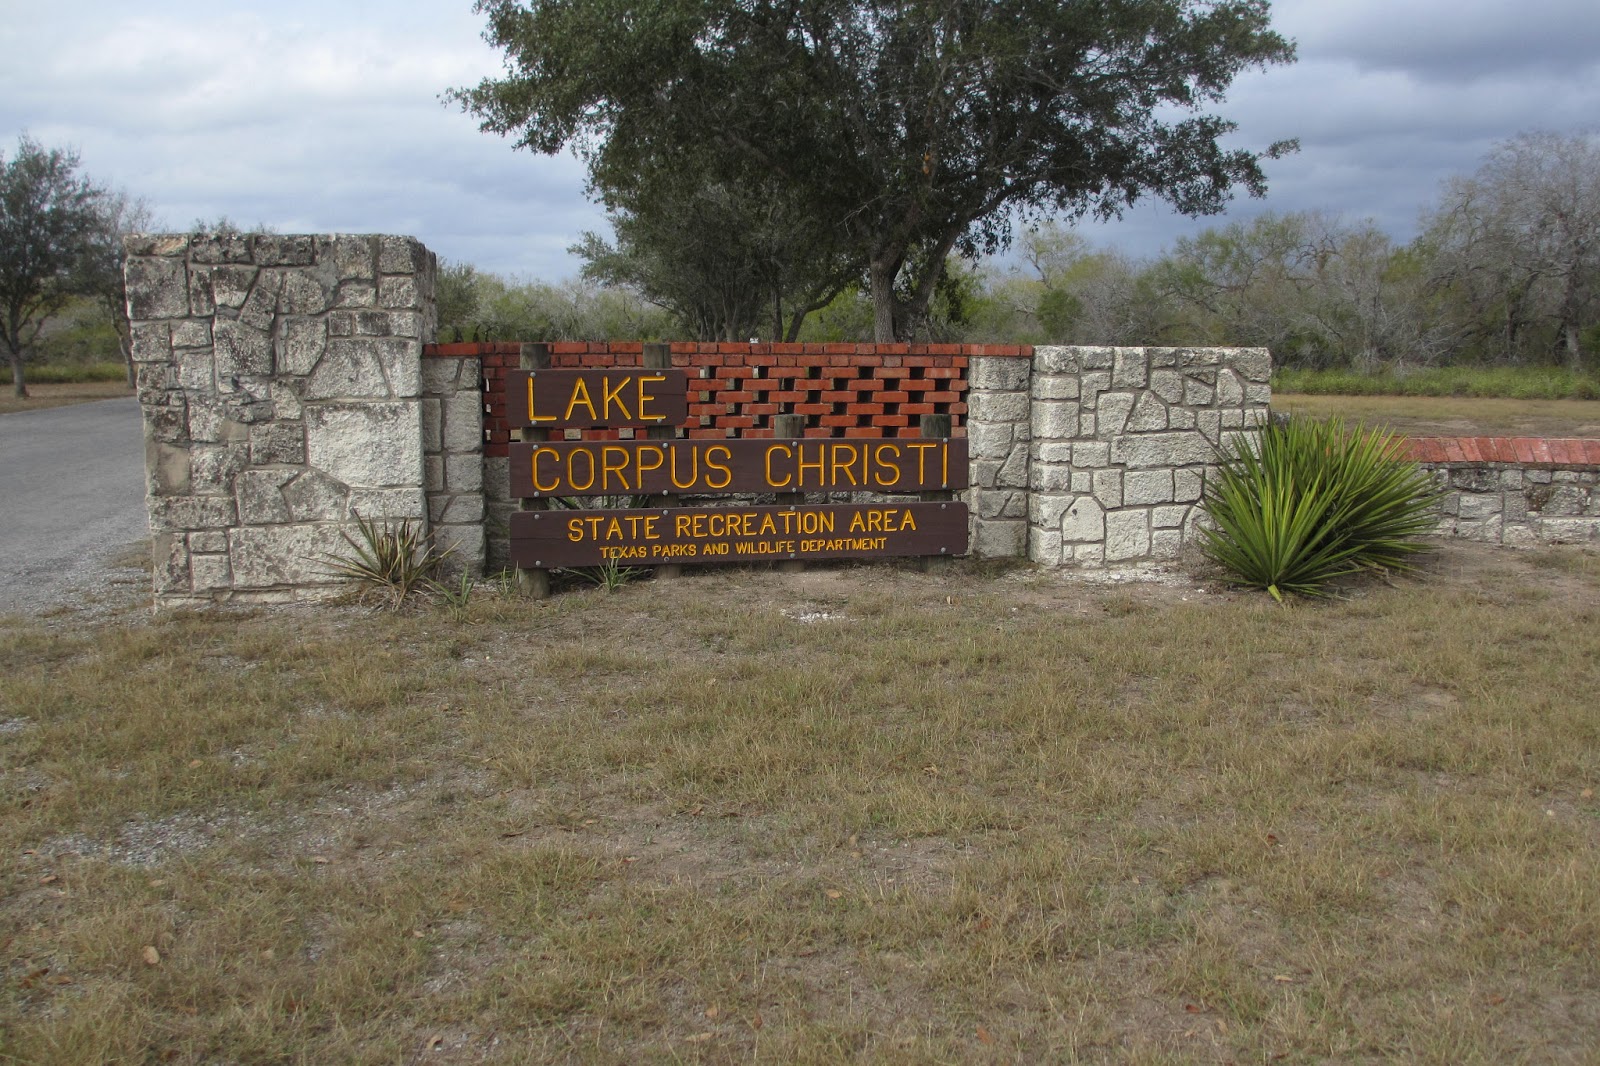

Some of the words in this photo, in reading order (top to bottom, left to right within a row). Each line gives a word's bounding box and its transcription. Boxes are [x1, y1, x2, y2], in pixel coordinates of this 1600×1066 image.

[527, 375, 667, 422] LAKE
[531, 444, 732, 491] CORPUS
[764, 442, 948, 488] CHRISTI
[567, 515, 661, 542] STATE
[675, 510, 835, 539] RECREATION
[848, 508, 917, 533] AREA
[599, 545, 647, 560] TEXAS
[651, 543, 697, 558] PARKS
[702, 541, 730, 556] AND
[734, 539, 796, 555] WILDLIFE
[800, 536, 888, 554] DEPARTMENT
